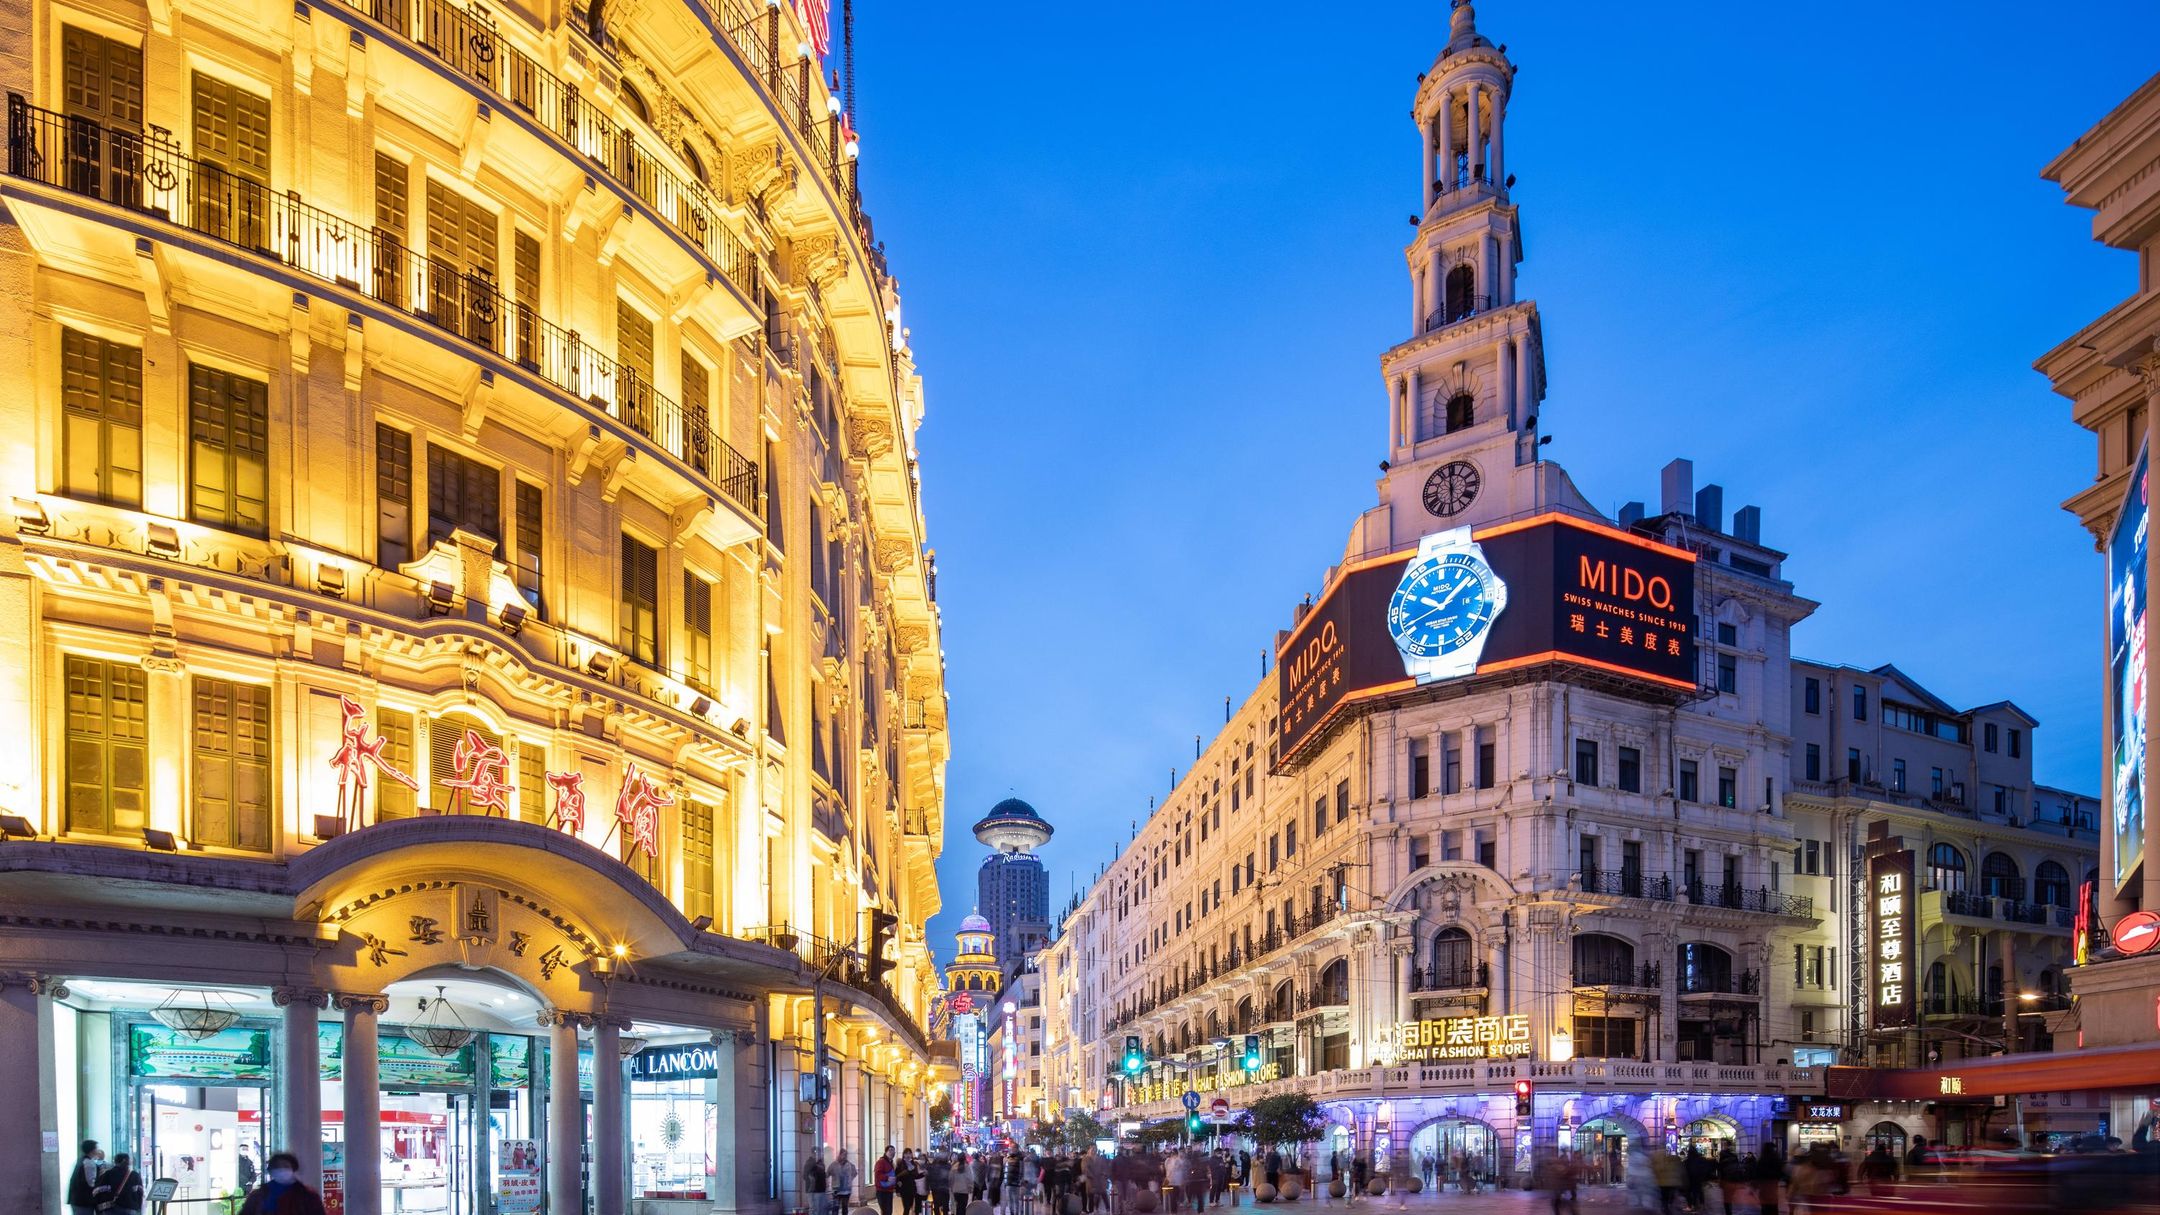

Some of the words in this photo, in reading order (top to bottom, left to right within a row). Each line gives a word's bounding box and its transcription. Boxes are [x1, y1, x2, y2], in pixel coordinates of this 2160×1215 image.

[1433, 583, 1451, 592] MIDO
[1580, 555, 1671, 609] MIDO
[1391, 607, 1399, 624] 45
[1564, 593, 1592, 607] SWISS
[1595, 601, 1635, 619] WATCHES
[1639, 613, 1665, 627] SINCE
[1669, 621, 1686, 632] 1918
[1570, 614, 1681, 656] 瑞士美度表
[1289, 620, 1335, 692] MIDO
[1002, 851, 1033, 864] Radisson
[1880, 873, 1902, 1006] 和颐至尊酒店
[649, 1047, 718, 1074] LANCÔM
[1432, 1045, 1484, 1059] FASHION
[1490, 1042, 1530, 1056] STORE
[1182, 1076, 1215, 1096] SHNGHAI
[1940, 1076, 1962, 1095] 和颐
